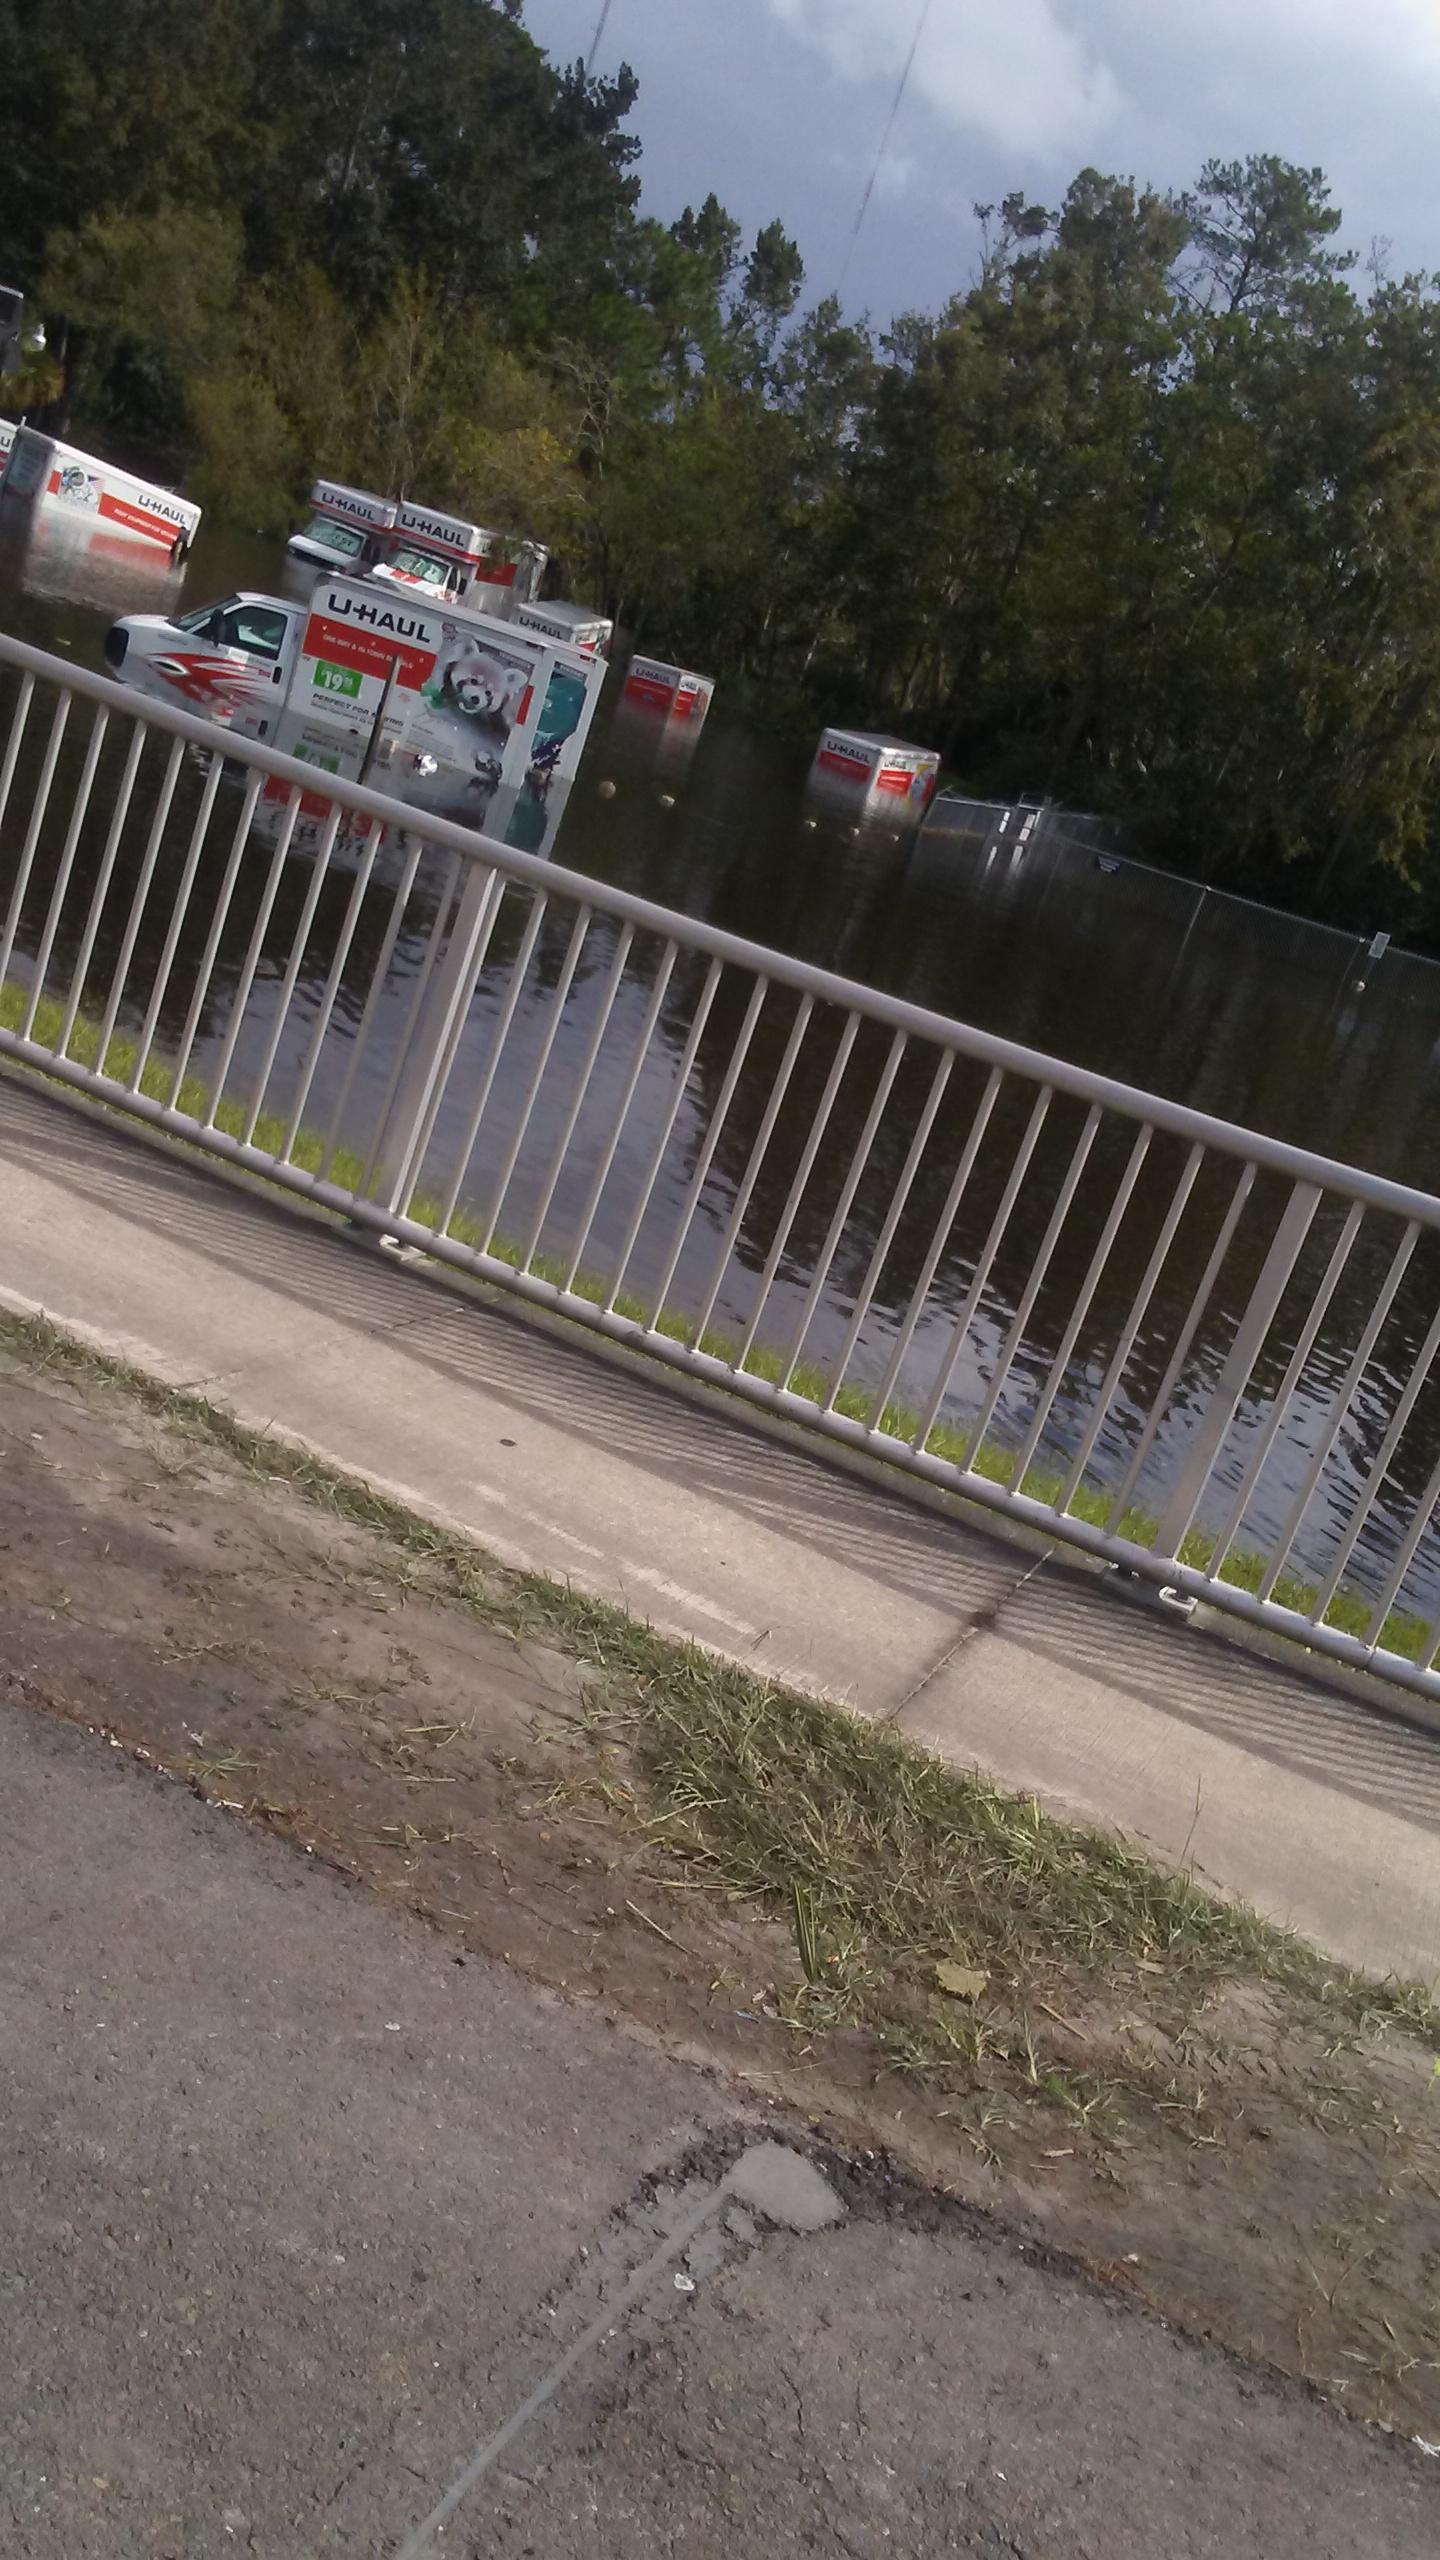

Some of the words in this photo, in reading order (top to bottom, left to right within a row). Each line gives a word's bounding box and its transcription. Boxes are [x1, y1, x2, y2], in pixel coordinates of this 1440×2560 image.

[138, 494, 187, 525] U-HAUL
[322, 492, 375, 521] U-HAUL
[402, 513, 465, 547] U-HAUL
[328, 594, 430, 643] U-HAUL
[519, 616, 563, 640] U-HAUL
[827, 741, 870, 764] U-HAUL
